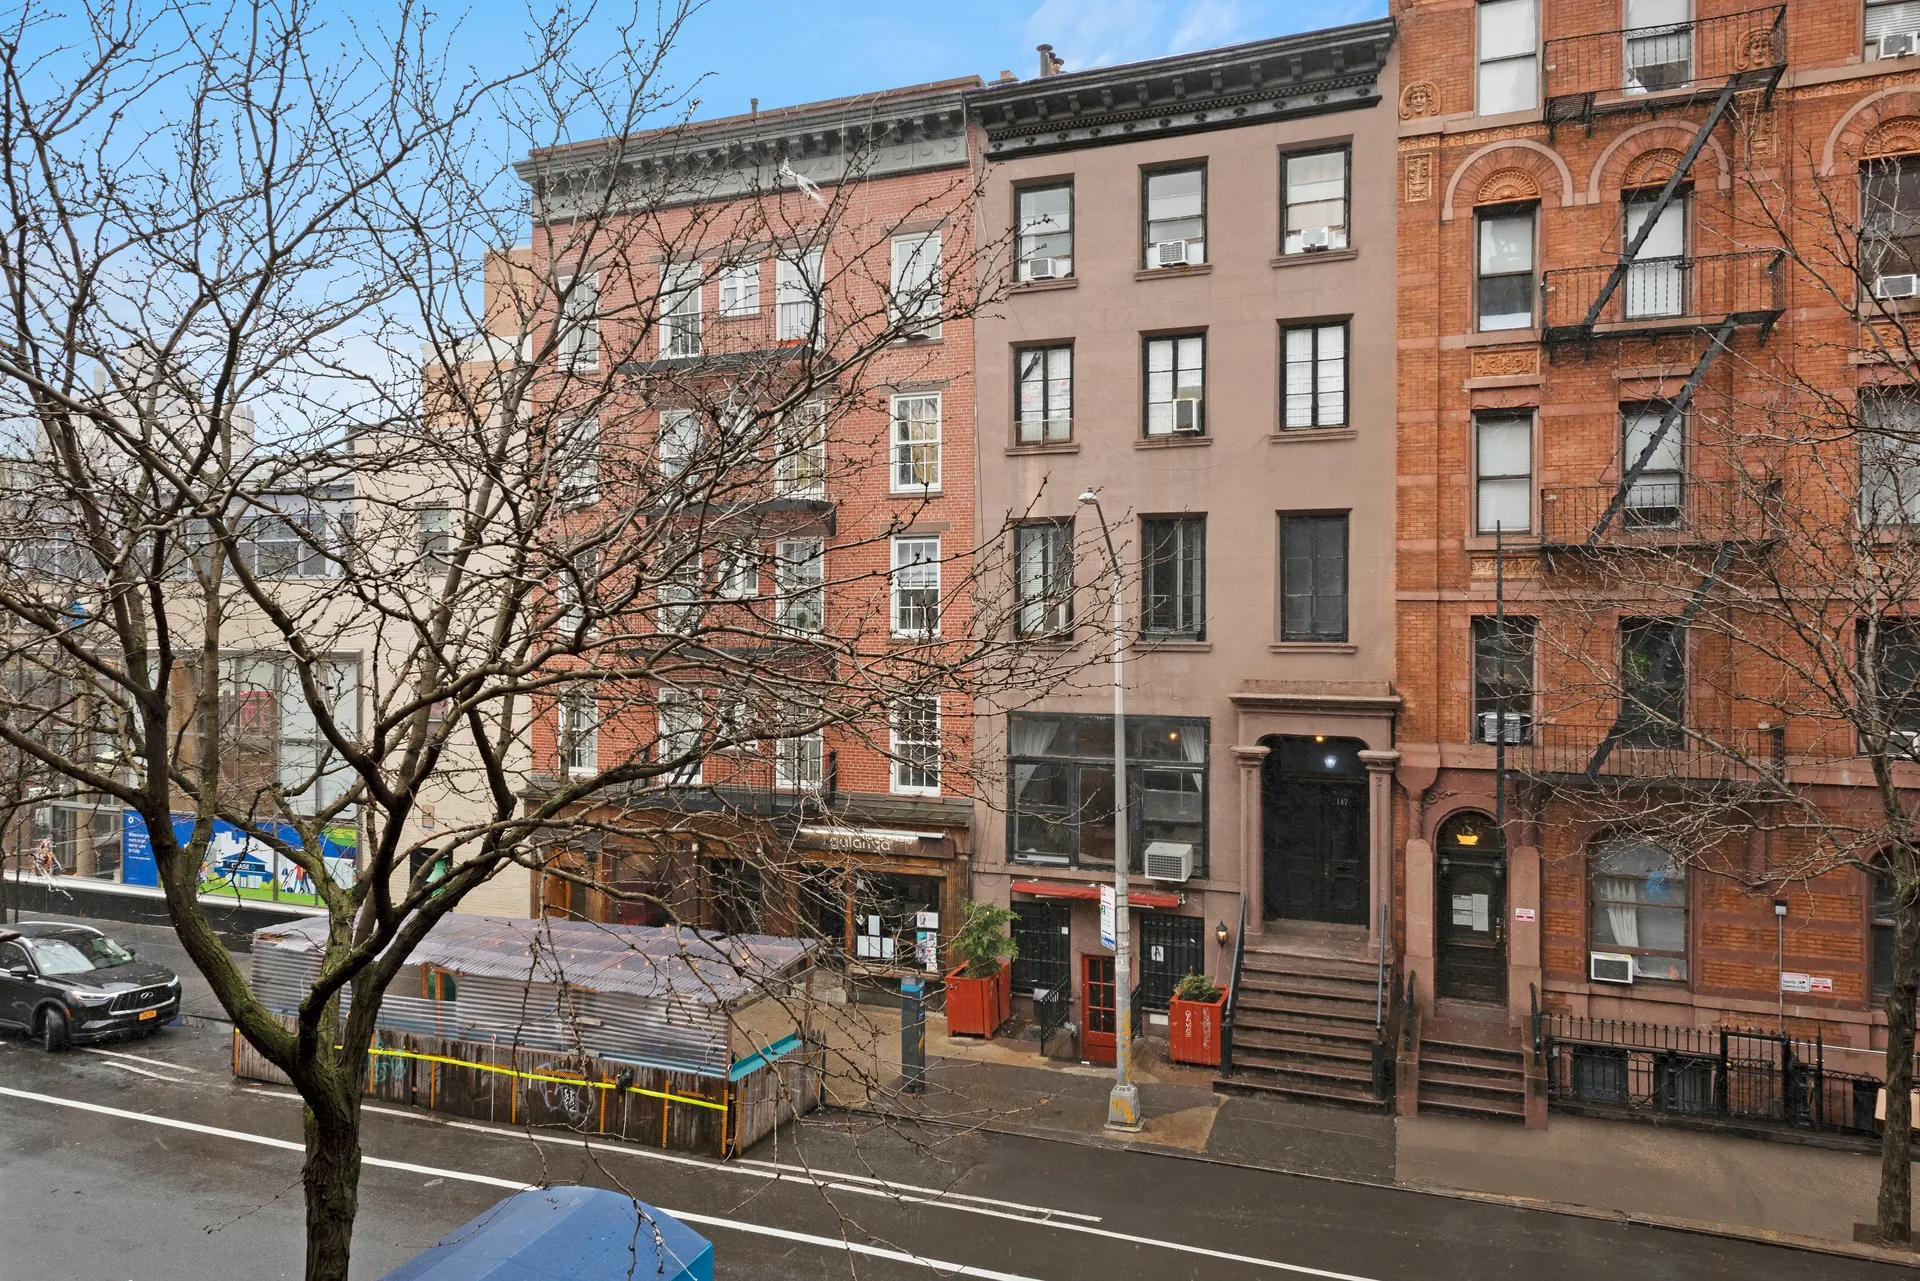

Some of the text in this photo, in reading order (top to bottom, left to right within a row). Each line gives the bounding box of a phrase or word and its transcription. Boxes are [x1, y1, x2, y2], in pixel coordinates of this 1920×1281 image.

[1336, 798, 1349, 806] 147
[829, 836, 891, 852] galanga
[1154, 947, 1161, 957] A
